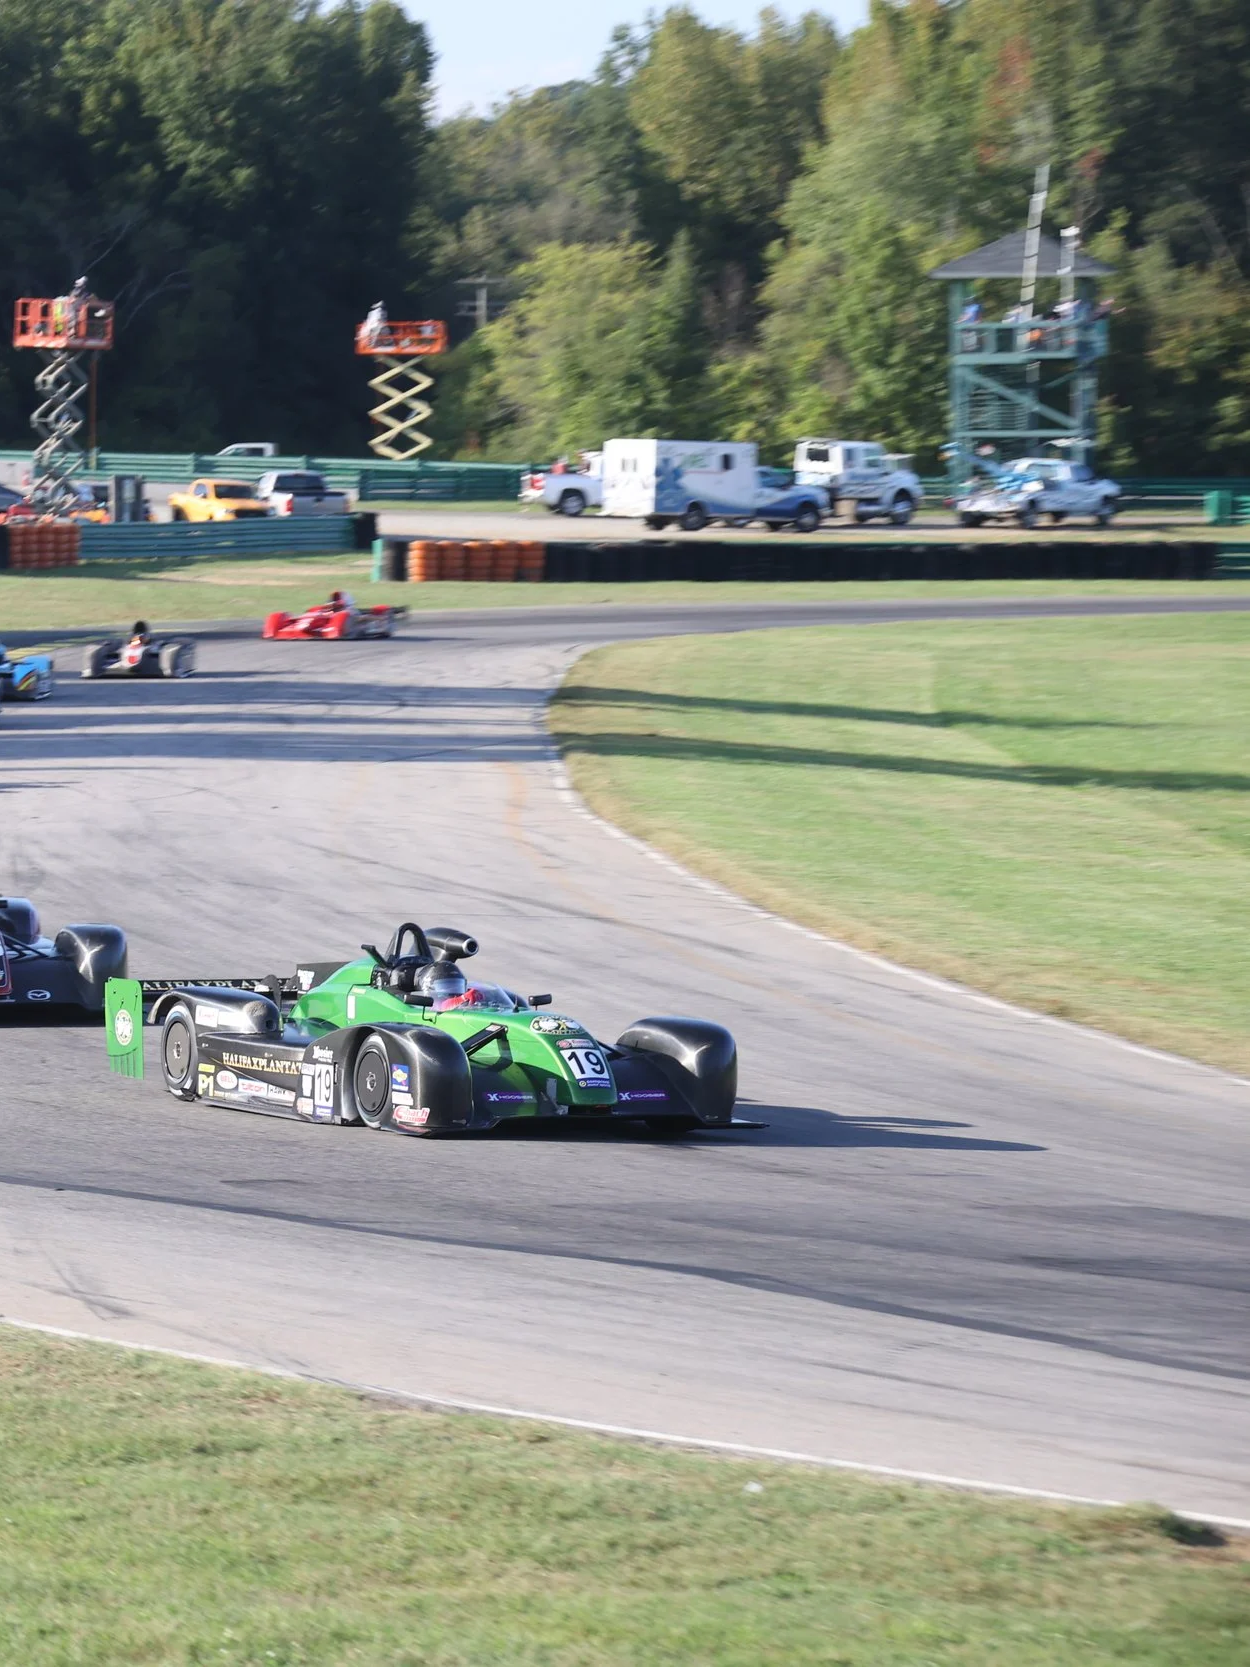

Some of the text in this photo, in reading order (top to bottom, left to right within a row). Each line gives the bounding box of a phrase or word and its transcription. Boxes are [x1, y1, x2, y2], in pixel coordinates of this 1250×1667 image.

[567, 1051, 606, 1075] 19
[198, 1073, 215, 1098] P1
[316, 1068, 332, 1103] 19
